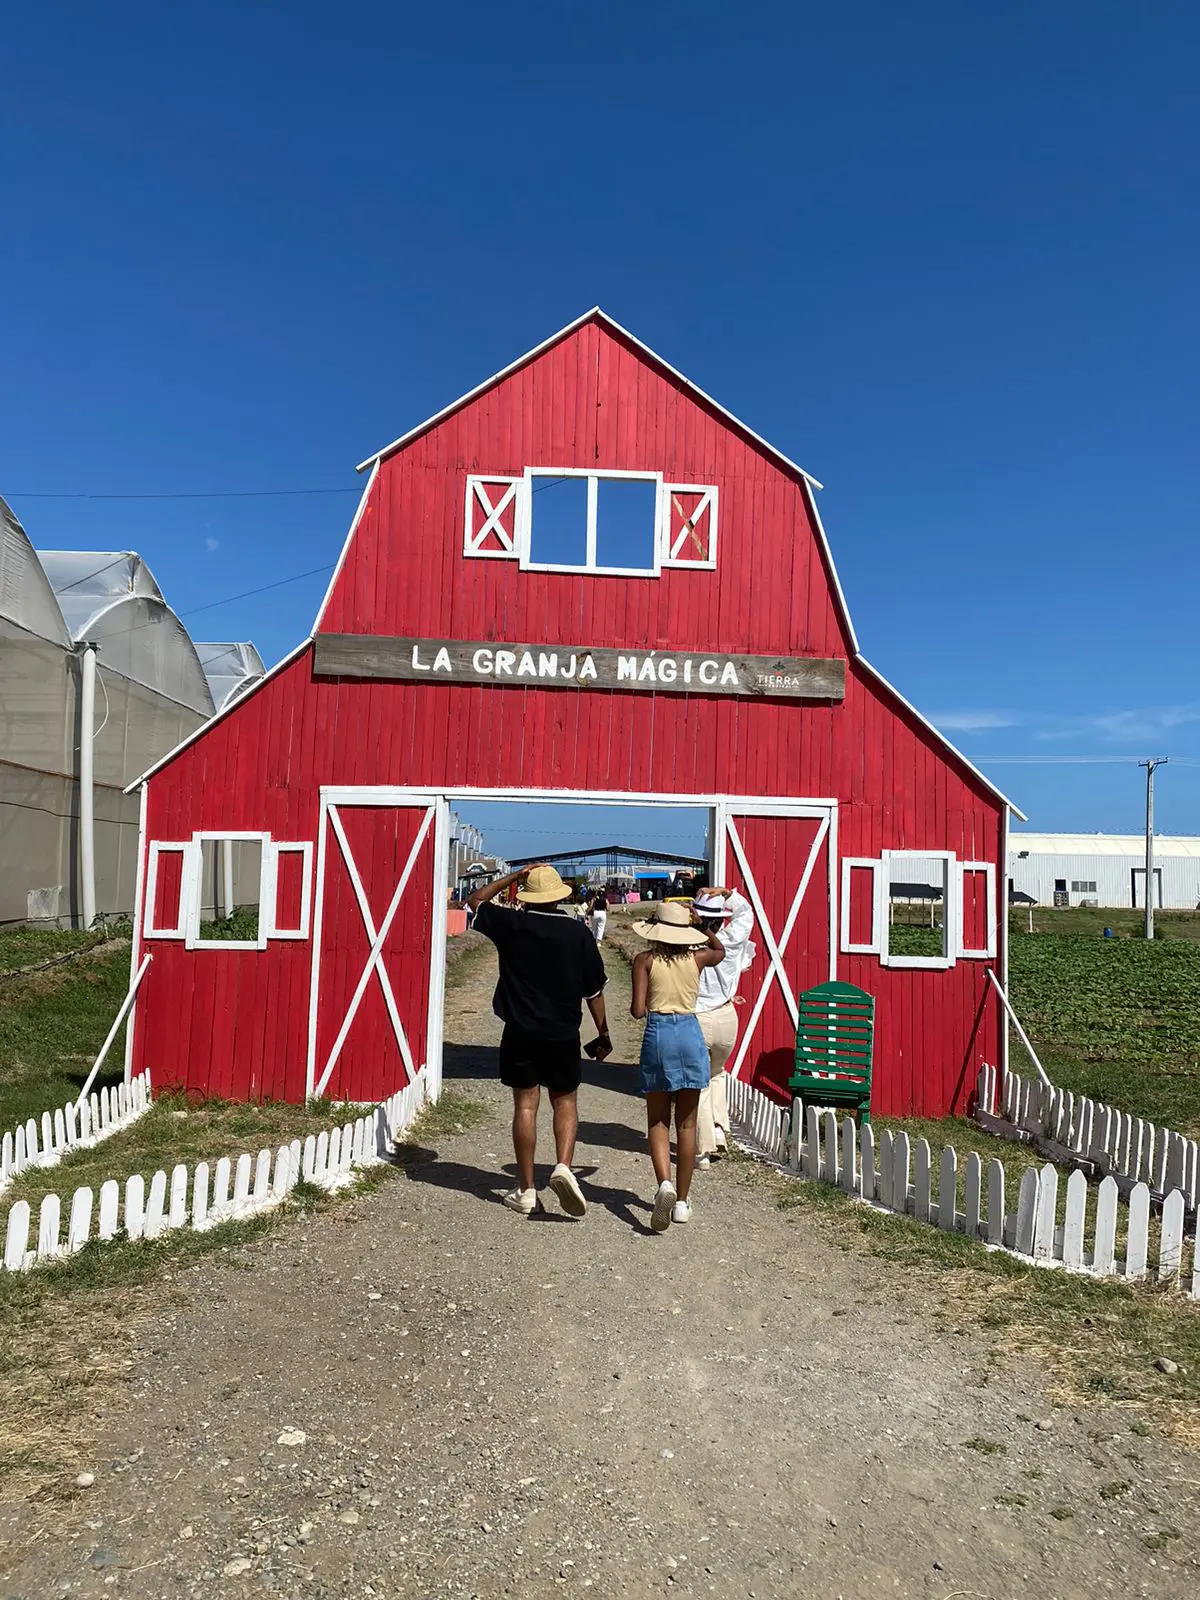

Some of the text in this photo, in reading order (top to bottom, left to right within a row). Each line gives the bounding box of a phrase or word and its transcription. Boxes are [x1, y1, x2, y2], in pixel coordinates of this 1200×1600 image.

[411, 644, 739, 685] LA GRANJA MÁGICA
[757, 674, 800, 686] TIERRA
